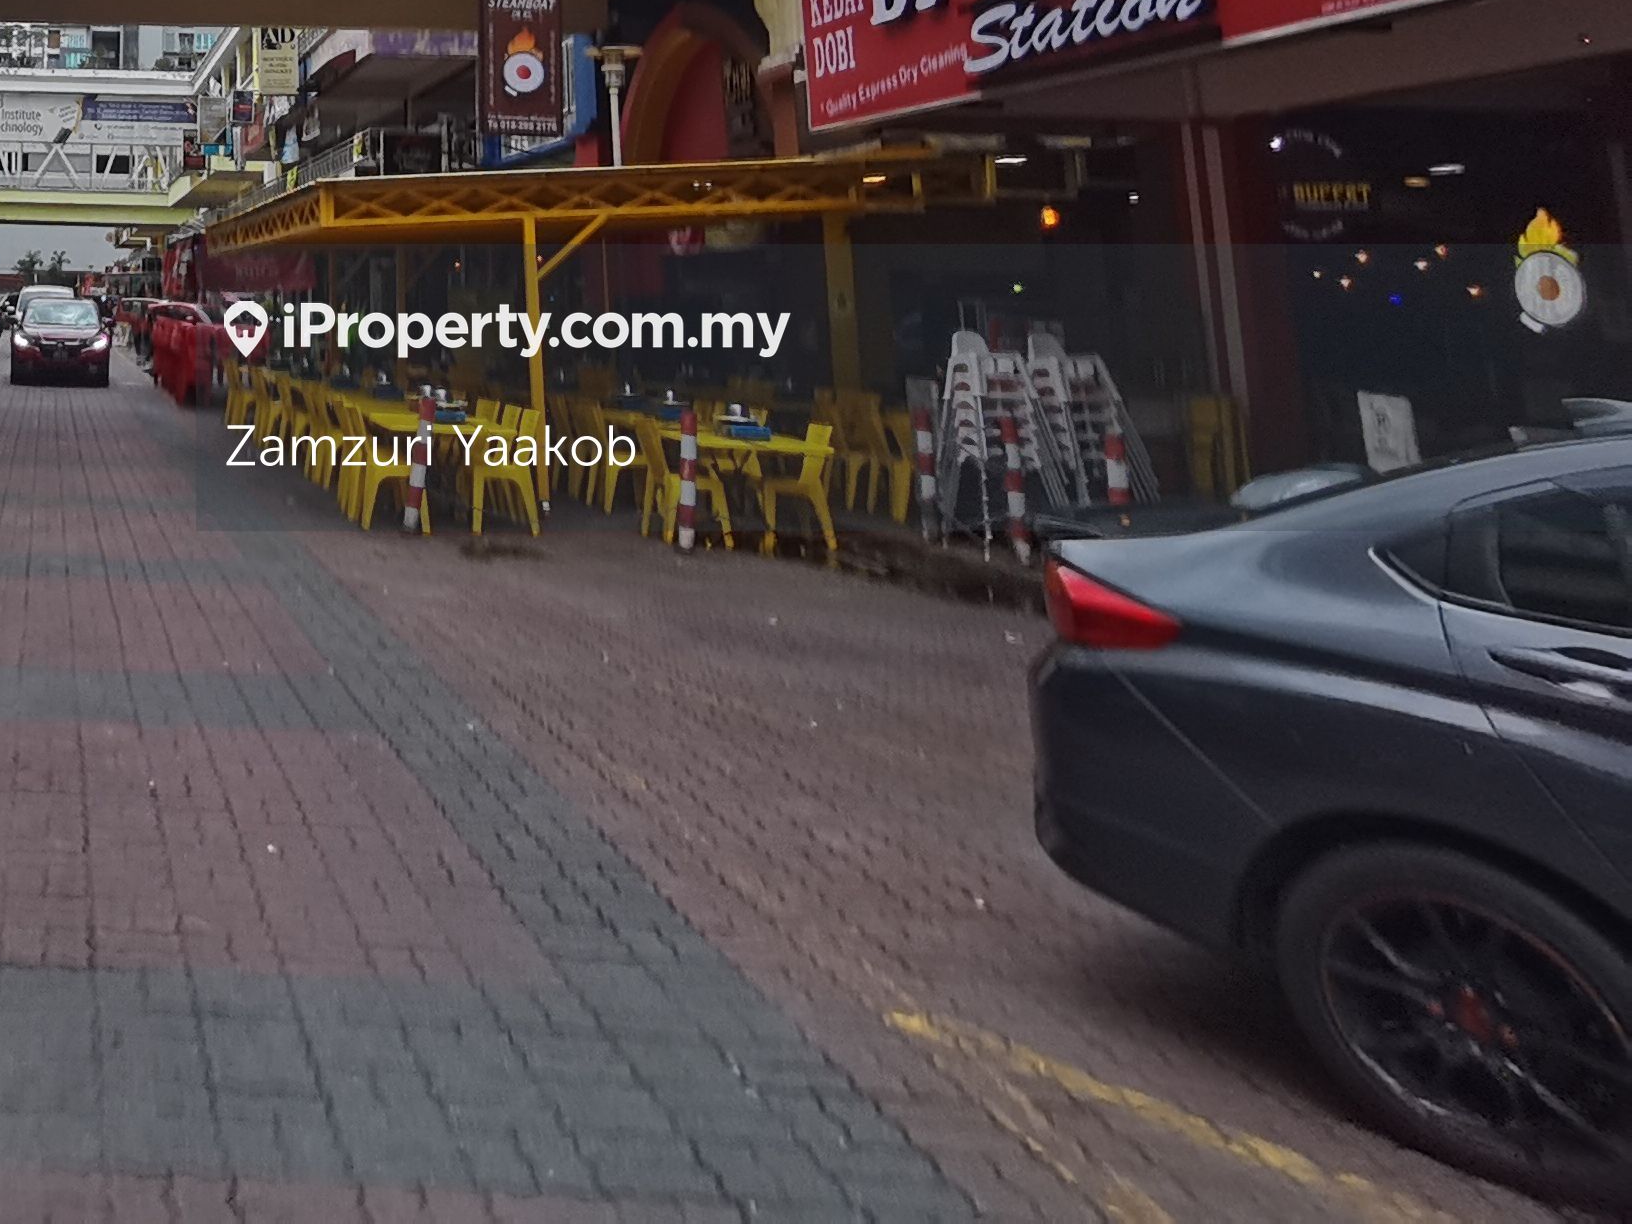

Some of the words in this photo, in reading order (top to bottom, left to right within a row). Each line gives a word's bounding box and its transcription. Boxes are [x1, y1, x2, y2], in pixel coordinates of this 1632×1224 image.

[812, 26, 857, 80] DOBI
[857, 73, 898, 102] Express
[898, 64, 918, 88] Dry
[919, 41, 969, 77] Cleaning
[1, 108, 42, 121] Institute
